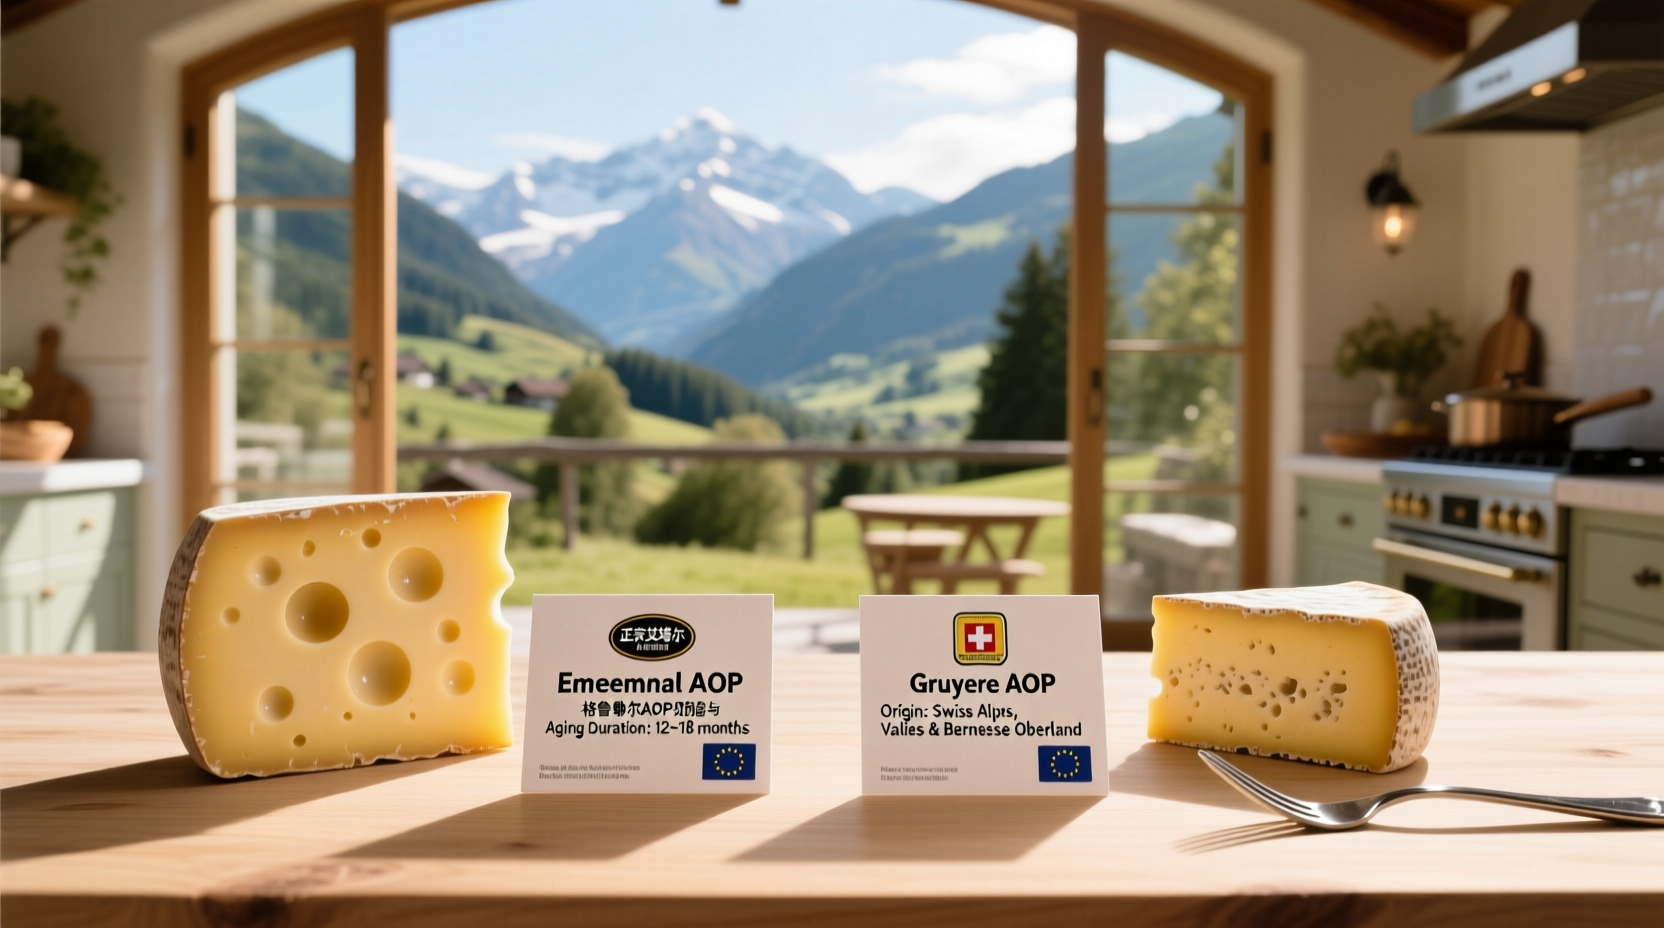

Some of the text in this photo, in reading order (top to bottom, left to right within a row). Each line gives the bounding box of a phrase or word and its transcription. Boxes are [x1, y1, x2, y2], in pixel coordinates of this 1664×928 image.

[558, 672, 743, 693] Emeemnal AOP
[910, 673, 1056, 699] Gruyere AOP
[881, 704, 928, 722] Origin:
[932, 704, 973, 718] Swiss
[545, 720, 750, 739] Aging Duration: 12-18 months
[881, 721, 925, 736] Valies
[928, 722, 940, 736] &
[1015, 721, 1082, 736] Oberland
